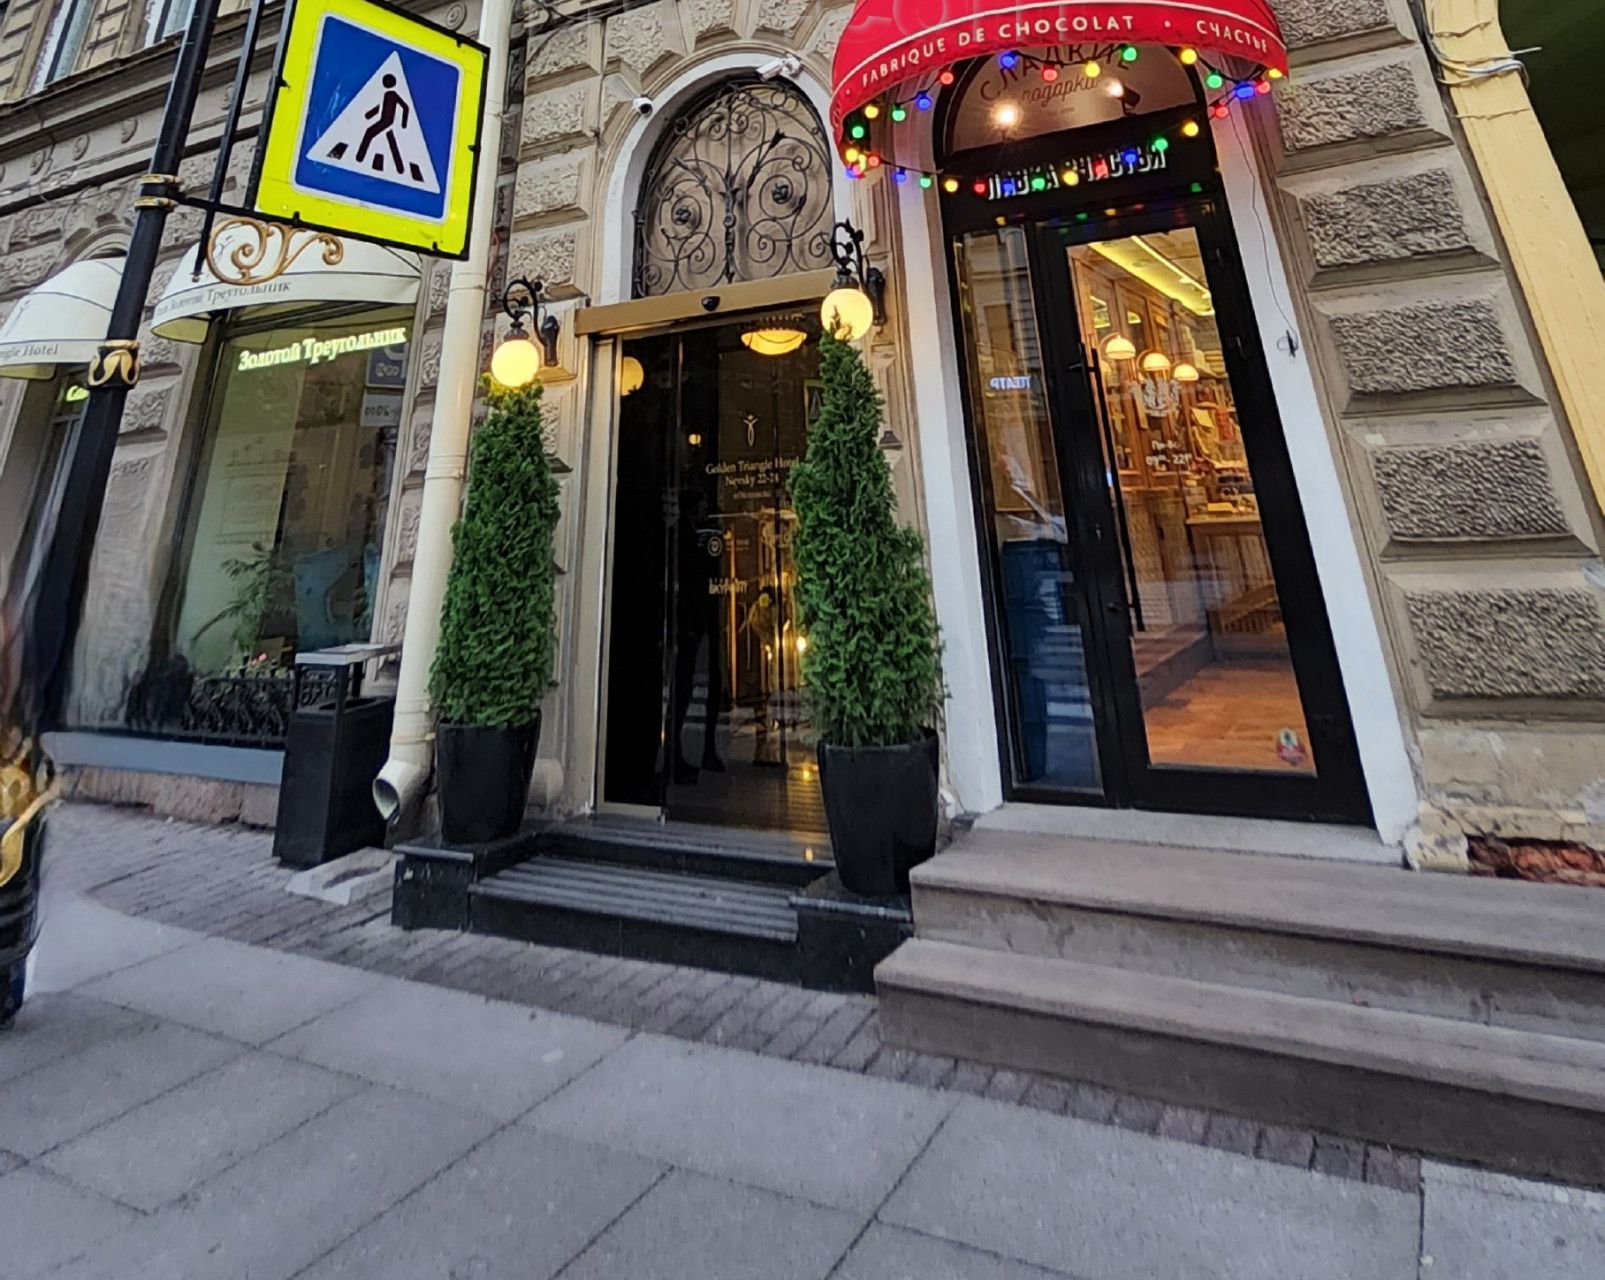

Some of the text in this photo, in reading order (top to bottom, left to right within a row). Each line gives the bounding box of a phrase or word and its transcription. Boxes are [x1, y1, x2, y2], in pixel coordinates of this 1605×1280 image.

[861, 15, 1135, 88] FABRIQUE DE CHOCOLAT
[1196, 19, 1269, 54] СЧАСТЬЕ
[238, 327, 407, 371] Золотой Треугольник
[739, 458, 772, 473] Triangle
